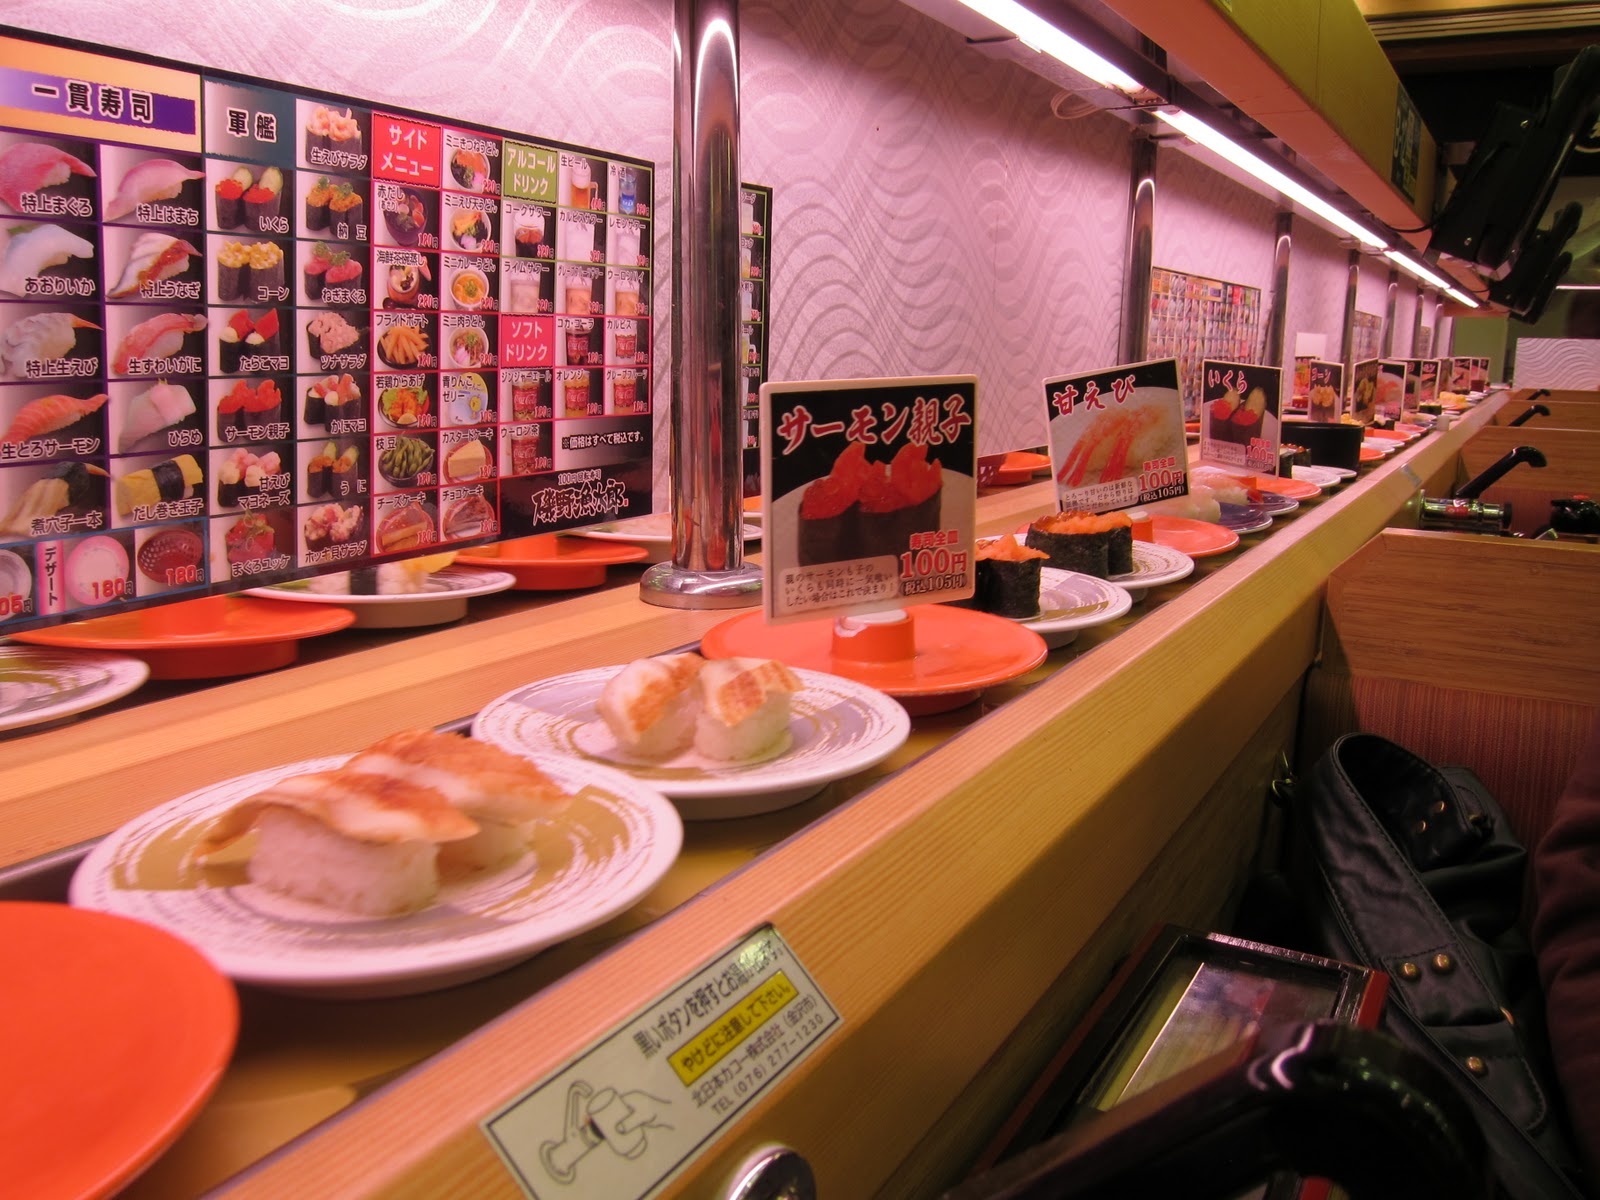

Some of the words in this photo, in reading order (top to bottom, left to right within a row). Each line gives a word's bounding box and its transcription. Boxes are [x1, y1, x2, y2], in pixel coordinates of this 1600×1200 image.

[32, 79, 153, 123] 一貫寿司
[227, 107, 277, 143] 軍艦
[389, 124, 427, 150] サイド
[311, 147, 367, 170] 生えびサラダ
[381, 152, 433, 176] メニュー
[507, 149, 556, 173] アルコール
[561, 155, 587, 170] 生ビール
[377, 185, 405, 200] 赤だし
[514, 174, 548, 195] ドリンク
[21, 192, 93, 216] 特上まぐろ
[137, 204, 199, 225] 特上はまち
[259, 215, 289, 233] いくら
[25, 277, 95, 296] あおりいか
[140, 281, 201, 299] 特上うなぎ
[258, 286, 289, 301] コーン
[322, 288, 366, 303] ねぎまぐろ
[376, 314, 429, 328] フライドポテト
[512, 321, 543, 339] ソフト
[321, 354, 366, 370] ツナサラダ
[506, 344, 547, 362] ドリンク
[26, 358, 98, 378] 特上生えび
[128, 357, 201, 374] 生すわいがに
[240, 355, 289, 371] たらこマヨ
[376, 374, 425, 389] 若鶏からあげ
[442, 375, 473, 388] 青りんご
[556, 369, 584, 381] オレンジ
[1208, 369, 1248, 394] いくら
[442, 390, 465, 403] ゼリー
[1052, 374, 1136, 416] 甘えび
[226, 423, 290, 442] サーモン親子
[331, 418, 366, 434] かにマヨ
[777, 393, 972, 455] サーモン親子
[168, 429, 203, 447] ひらめ
[442, 428, 494, 444] カスタードケーキ
[1, 436, 100, 460] 生とろサーモン
[259, 473, 290, 491] 甘えび
[1138, 469, 1184, 492] 100円
[238, 490, 290, 510] マヨネーズ
[377, 492, 427, 510] チーズケーキ
[442, 484, 484, 501] チョコケーキ
[134, 498, 204, 521] だし巻き玉子
[31, 511, 102, 536] 煮穴子一本
[305, 541, 367, 563] ホッキ貝サラダ
[232, 554, 290, 576] まぐろユッケ
[901, 548, 968, 579] 100円
[45, 547, 58, 606] デザート
[166, 565, 204, 586] 180円
[92, 578, 134, 599] 180円
[711, 1095, 734, 1114] TEL
